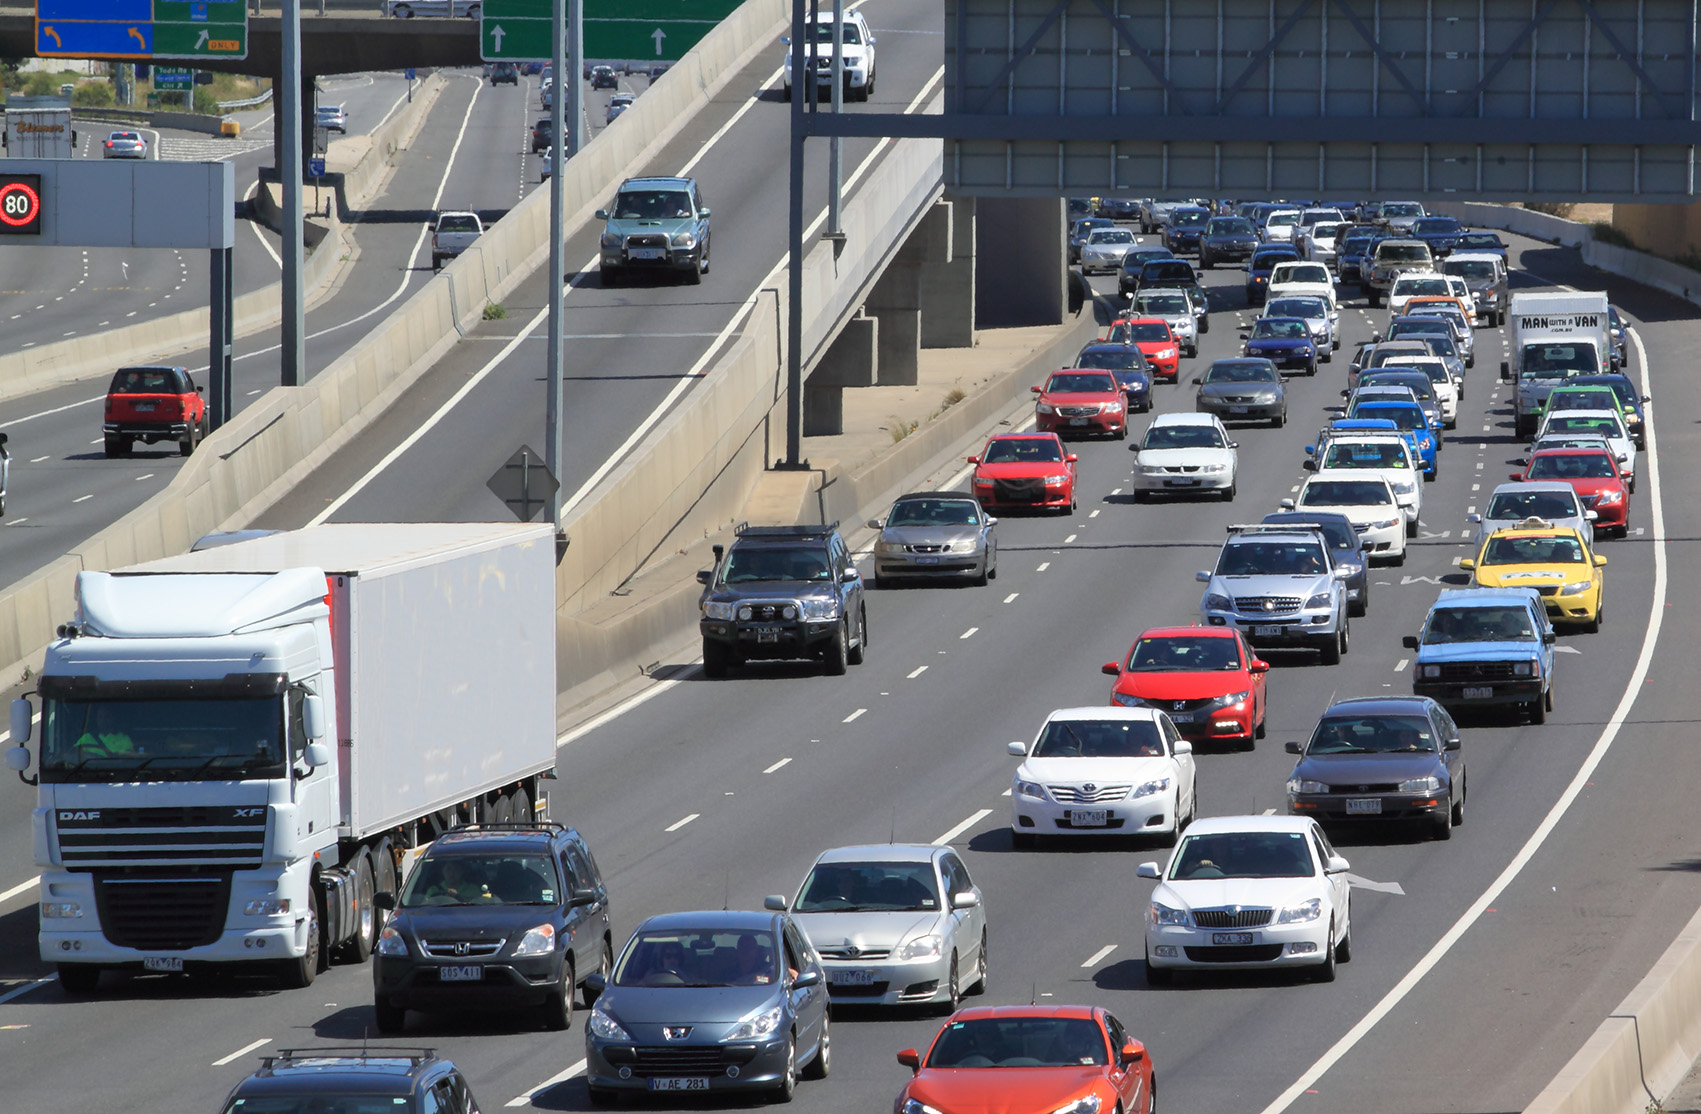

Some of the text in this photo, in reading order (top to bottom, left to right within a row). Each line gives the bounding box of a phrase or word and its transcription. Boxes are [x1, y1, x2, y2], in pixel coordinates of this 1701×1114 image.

[211, 41, 236, 49] ONLY
[6, 195, 28, 213] 80
[1522, 317, 1549, 329] MAN
[1575, 316, 1598, 328] VAN
[59, 811, 100, 821] DAF
[232, 808, 264, 818] XF
[686, 1079, 705, 1089] 281
